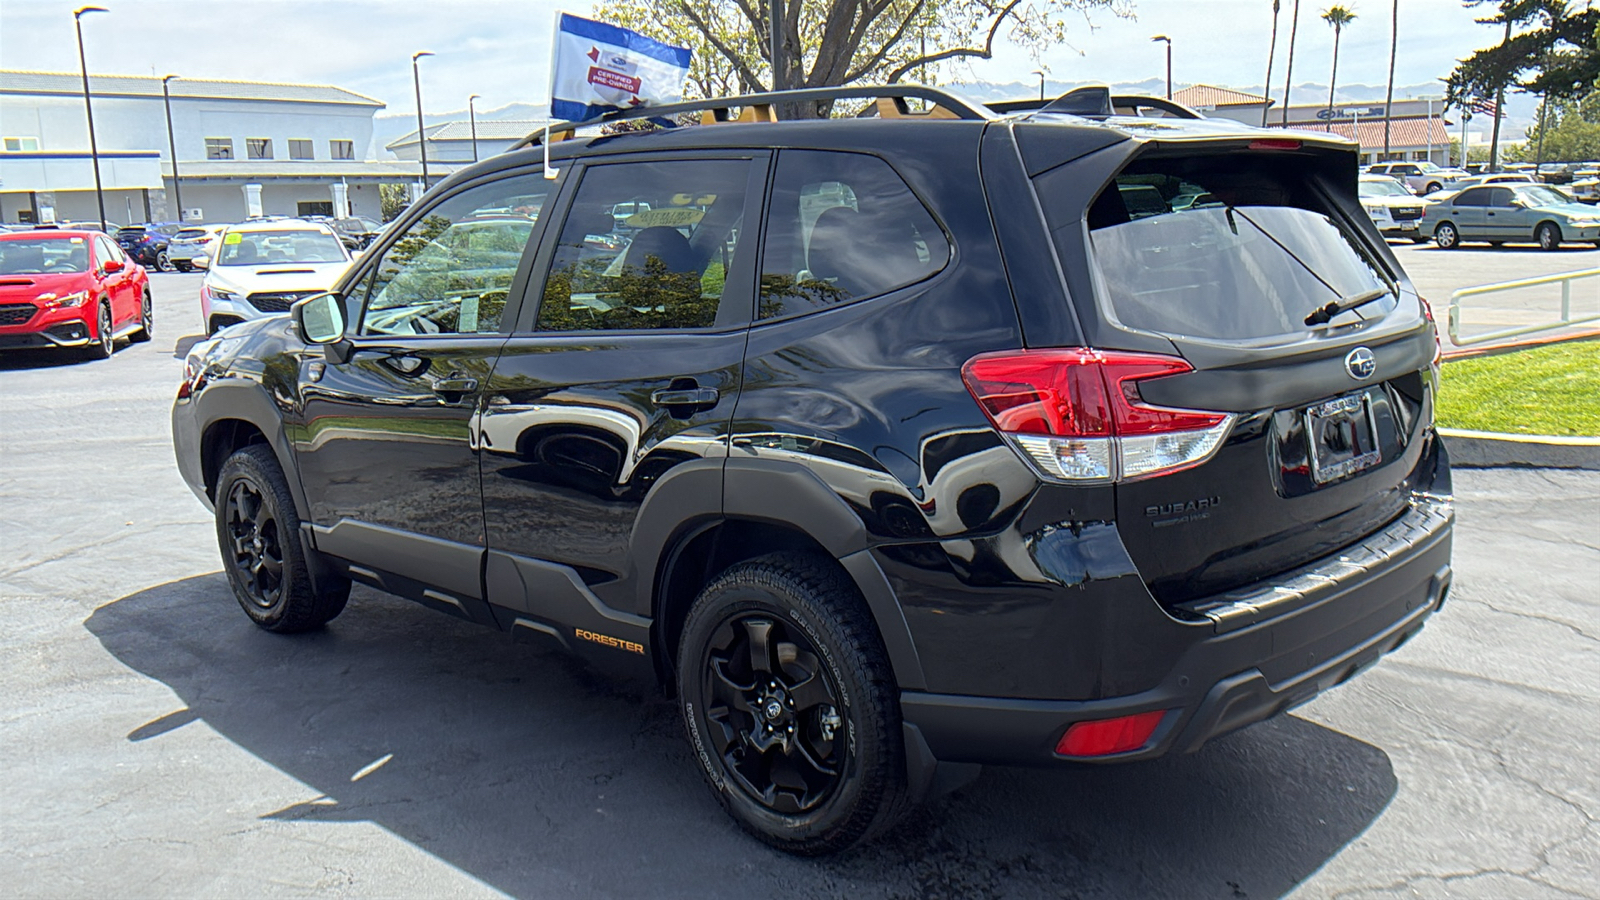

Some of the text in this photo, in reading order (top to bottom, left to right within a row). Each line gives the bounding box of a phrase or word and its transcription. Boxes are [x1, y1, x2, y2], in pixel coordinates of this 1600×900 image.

[592, 75, 635, 91] PRE-OWNED
[597, 70, 632, 85] CERTIFIED
[1145, 495, 1221, 517] SUBARU
[575, 628, 645, 655] FORESTER
